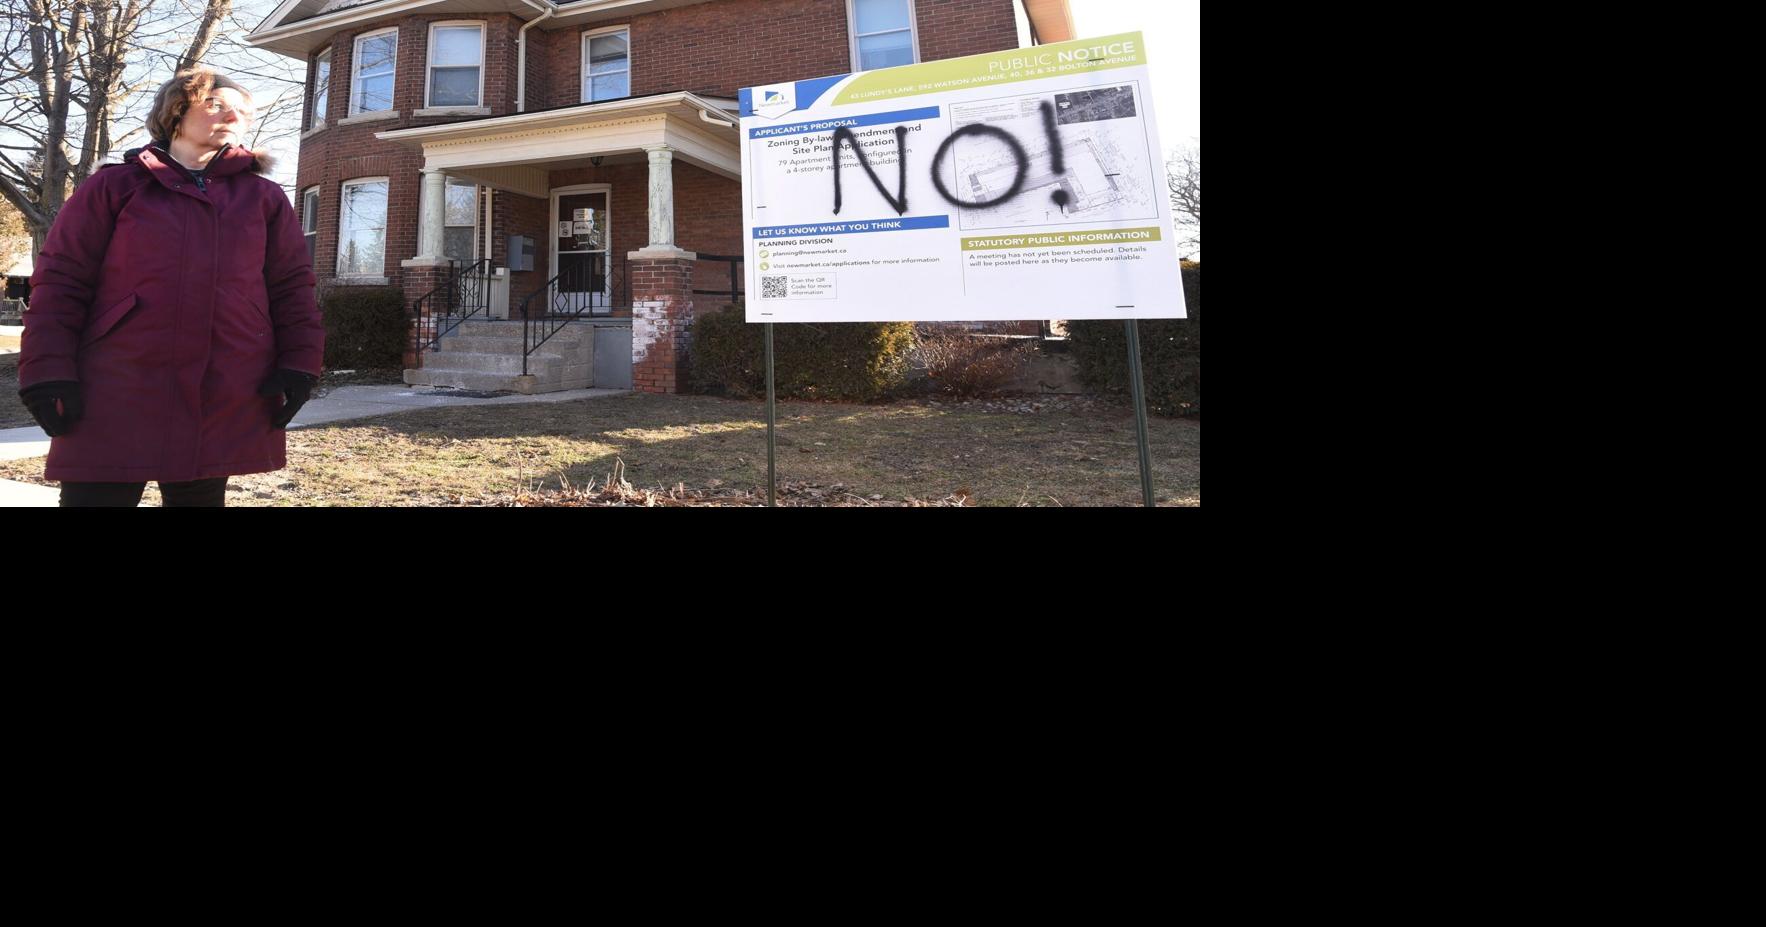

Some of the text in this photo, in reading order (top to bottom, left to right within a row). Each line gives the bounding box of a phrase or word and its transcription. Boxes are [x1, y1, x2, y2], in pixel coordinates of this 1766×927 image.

[989, 41, 1135, 72] PUBLIC NOTICE
[934, 78, 969, 88] WATSON
[1059, 60, 1096, 71] BOLTON
[1098, 56, 1136, 66] AVENUE
[754, 120, 858, 136] APPLICANT'S PROPOSAL
[768, 139, 800, 147] Zoning
[802, 135, 834, 144] By-law
[836, 129, 899, 140] endmen
[790, 156, 830, 166] Apartment
[833, 153, 855, 161] nits,
[968, 231, 1150, 247] STATUTORY PUBLIC INFORMATION
